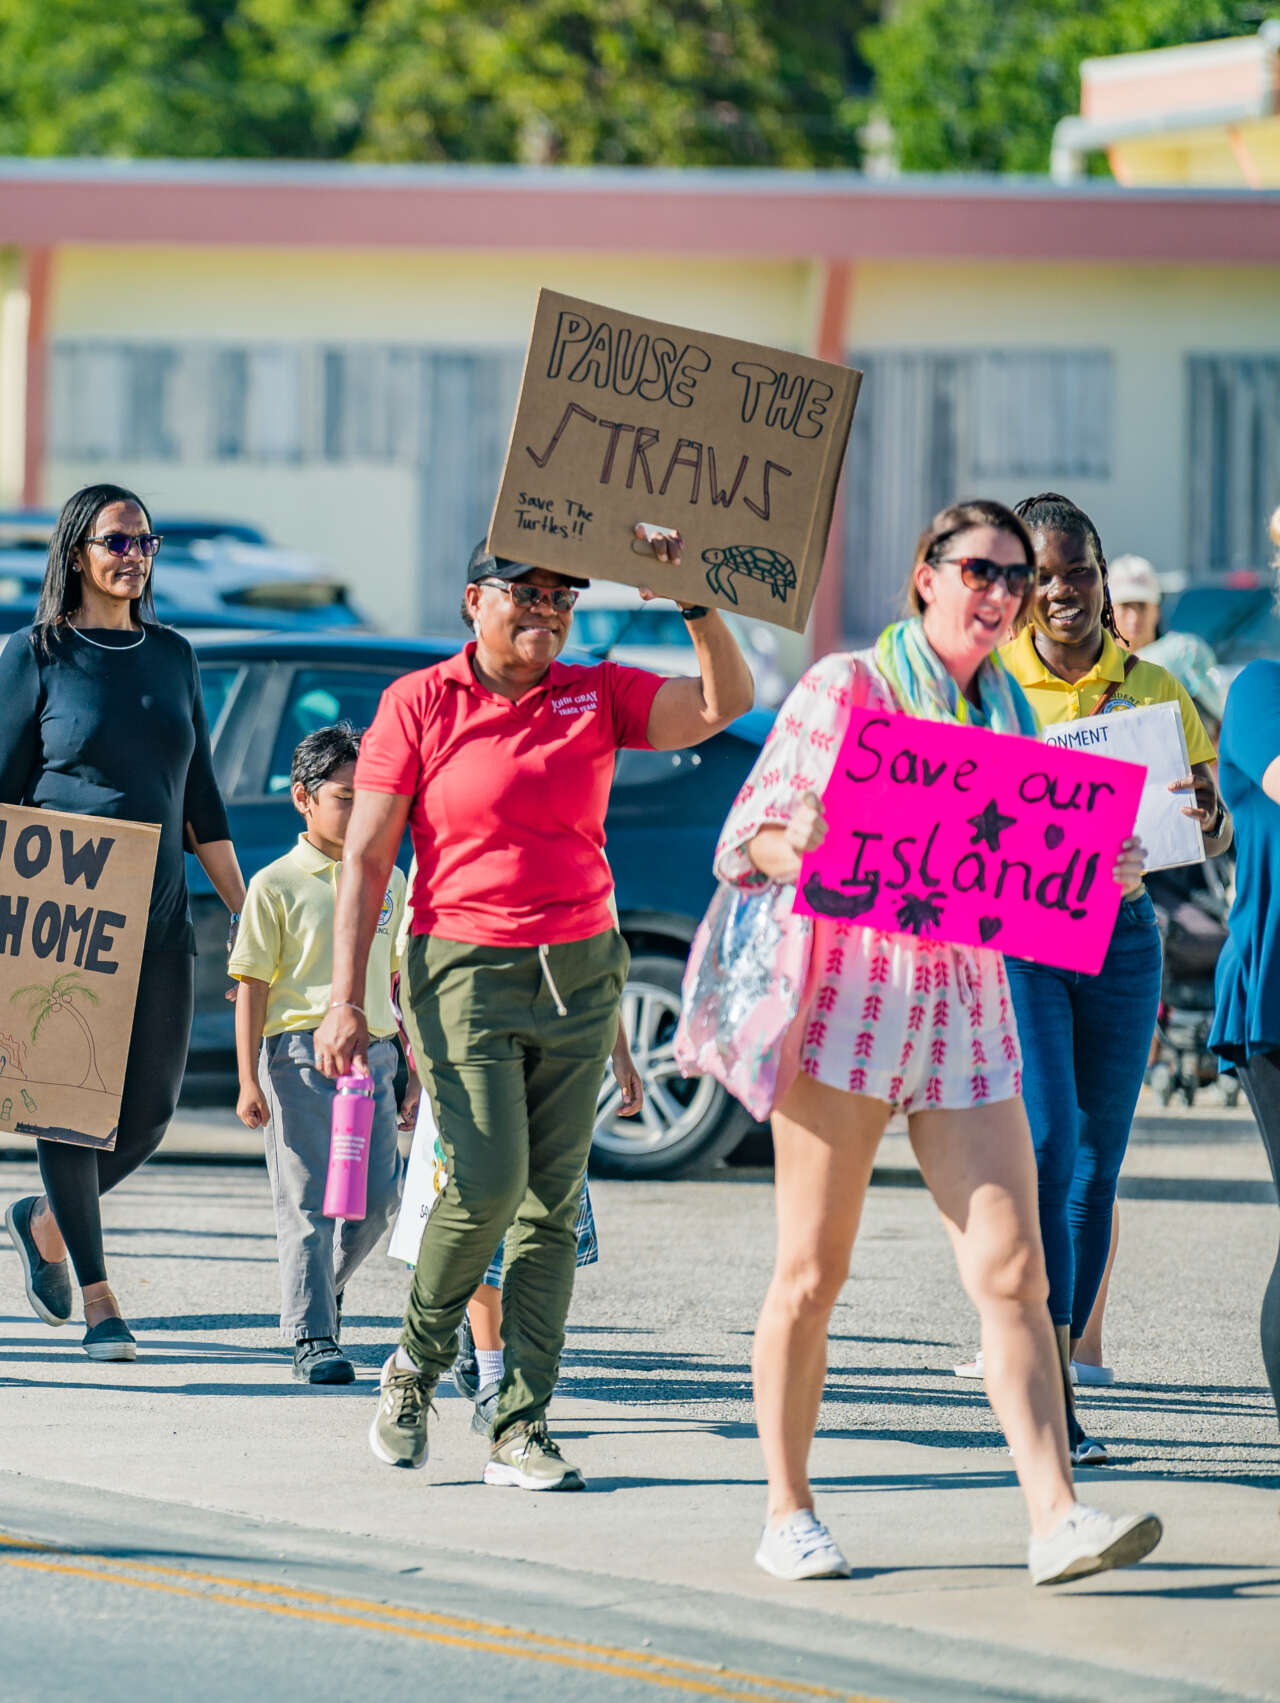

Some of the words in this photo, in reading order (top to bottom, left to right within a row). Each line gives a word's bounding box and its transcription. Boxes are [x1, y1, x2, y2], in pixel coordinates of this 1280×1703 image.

[547, 312, 711, 407] PAUSE
[733, 361, 834, 439] THE
[526, 402, 793, 521] STRAWS
[514, 510, 585, 542] Turtles!!
[566, 499, 593, 521] The
[552, 696, 573, 713] JOHN
[575, 690, 598, 704] GRAY
[845, 718, 979, 793] Save
[1018, 772, 1115, 813] our
